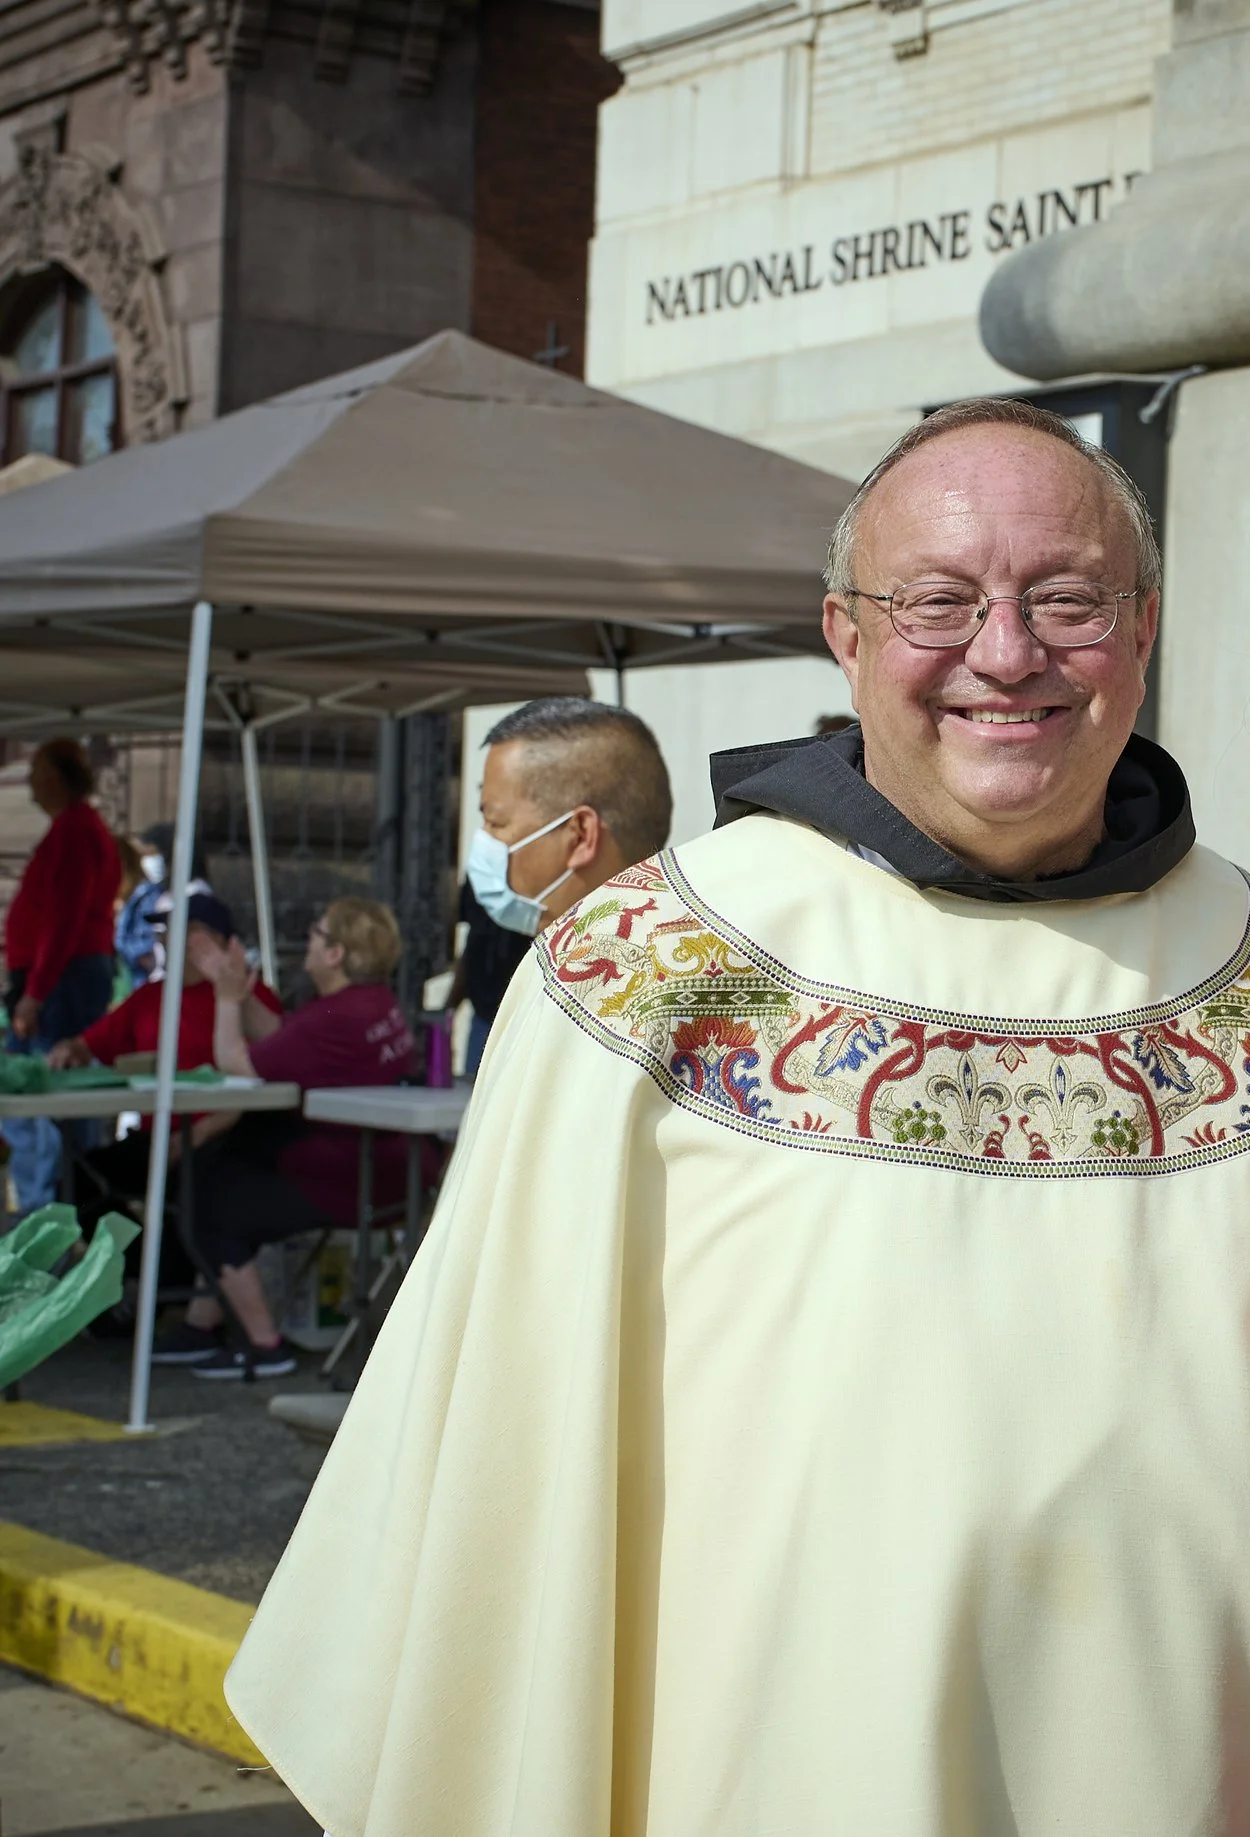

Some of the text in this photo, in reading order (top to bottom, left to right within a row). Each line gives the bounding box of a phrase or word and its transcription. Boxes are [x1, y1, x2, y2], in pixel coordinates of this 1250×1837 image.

[645, 178, 1112, 325] NATIONAL SHRINE SAINT
